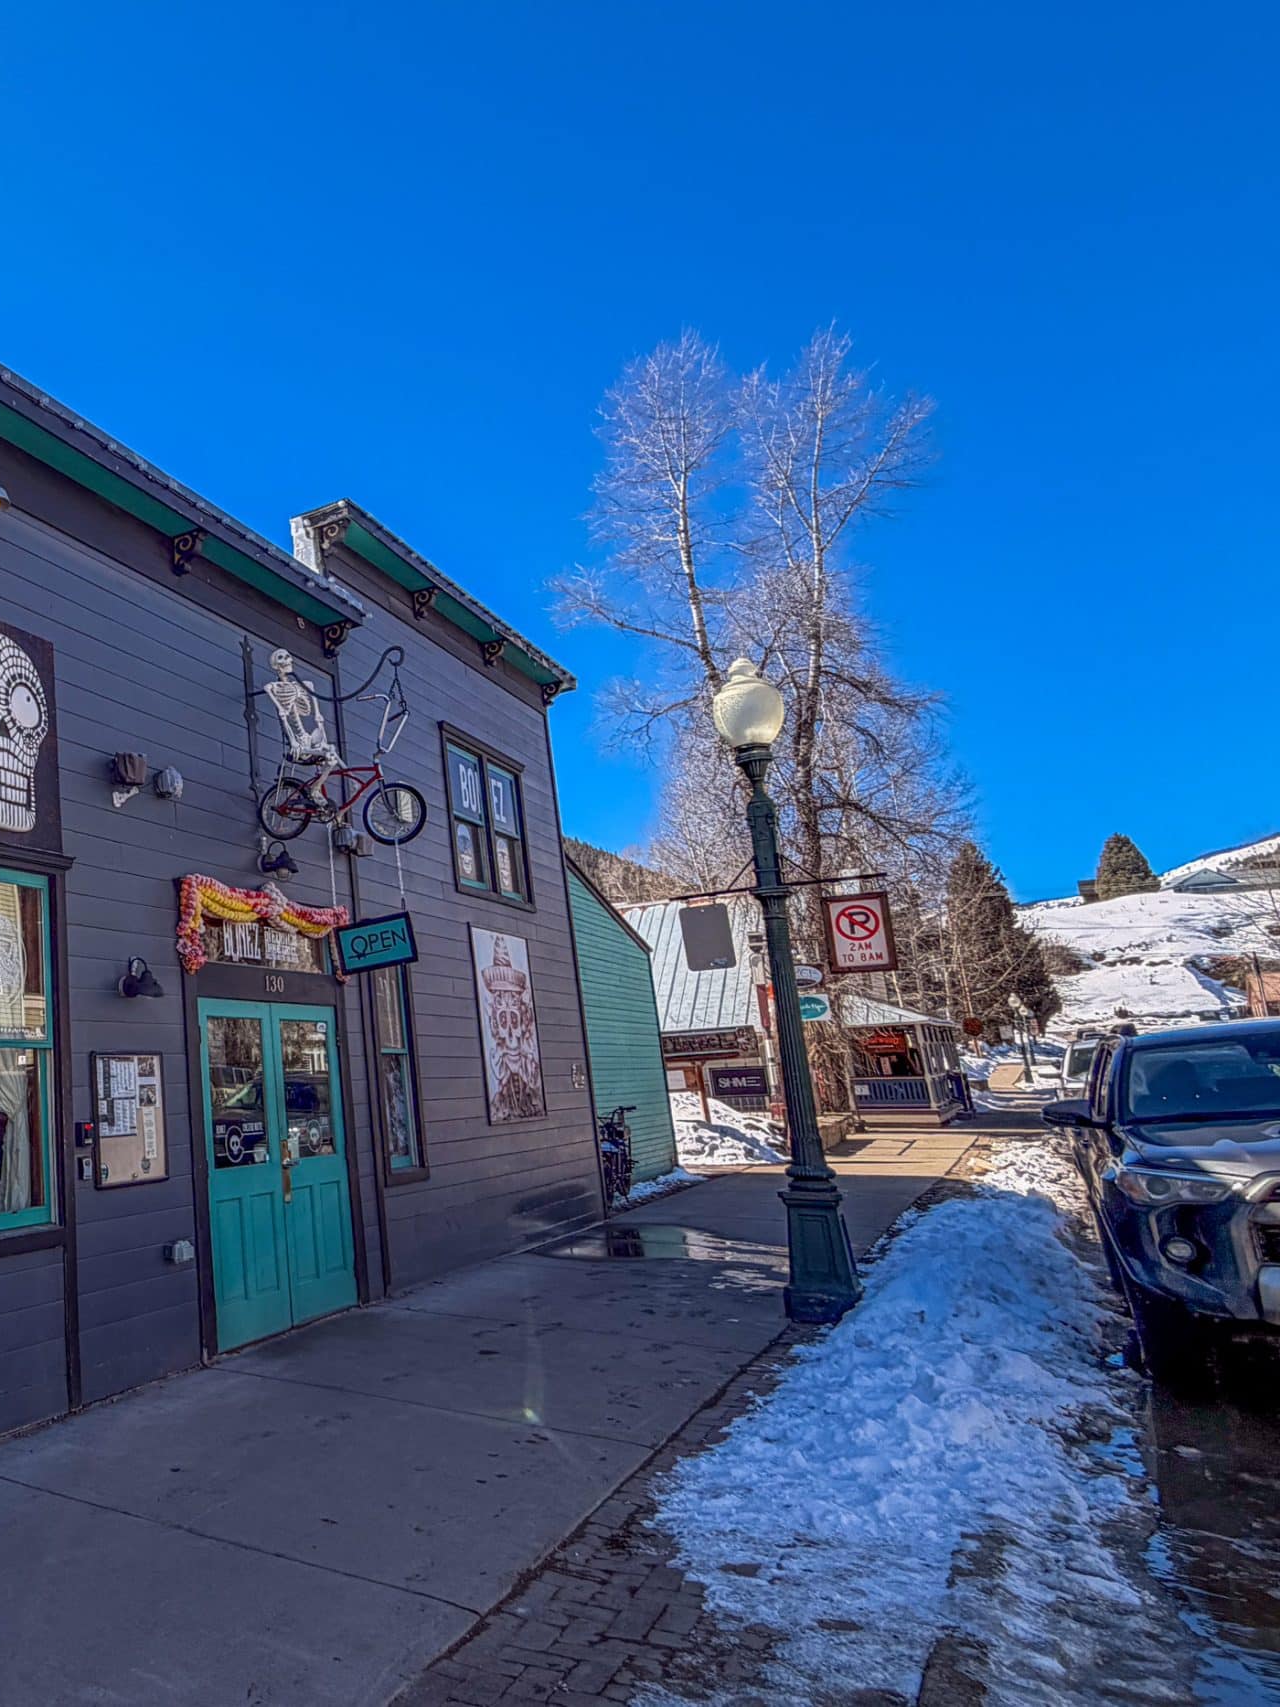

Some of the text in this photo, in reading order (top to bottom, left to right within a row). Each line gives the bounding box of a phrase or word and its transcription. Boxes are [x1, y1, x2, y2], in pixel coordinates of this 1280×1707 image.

[350, 927, 408, 957] OPEN
[849, 943, 872, 952] 2AM
[842, 952, 883, 963] TO 8AM
[264, 975, 284, 992] 130
